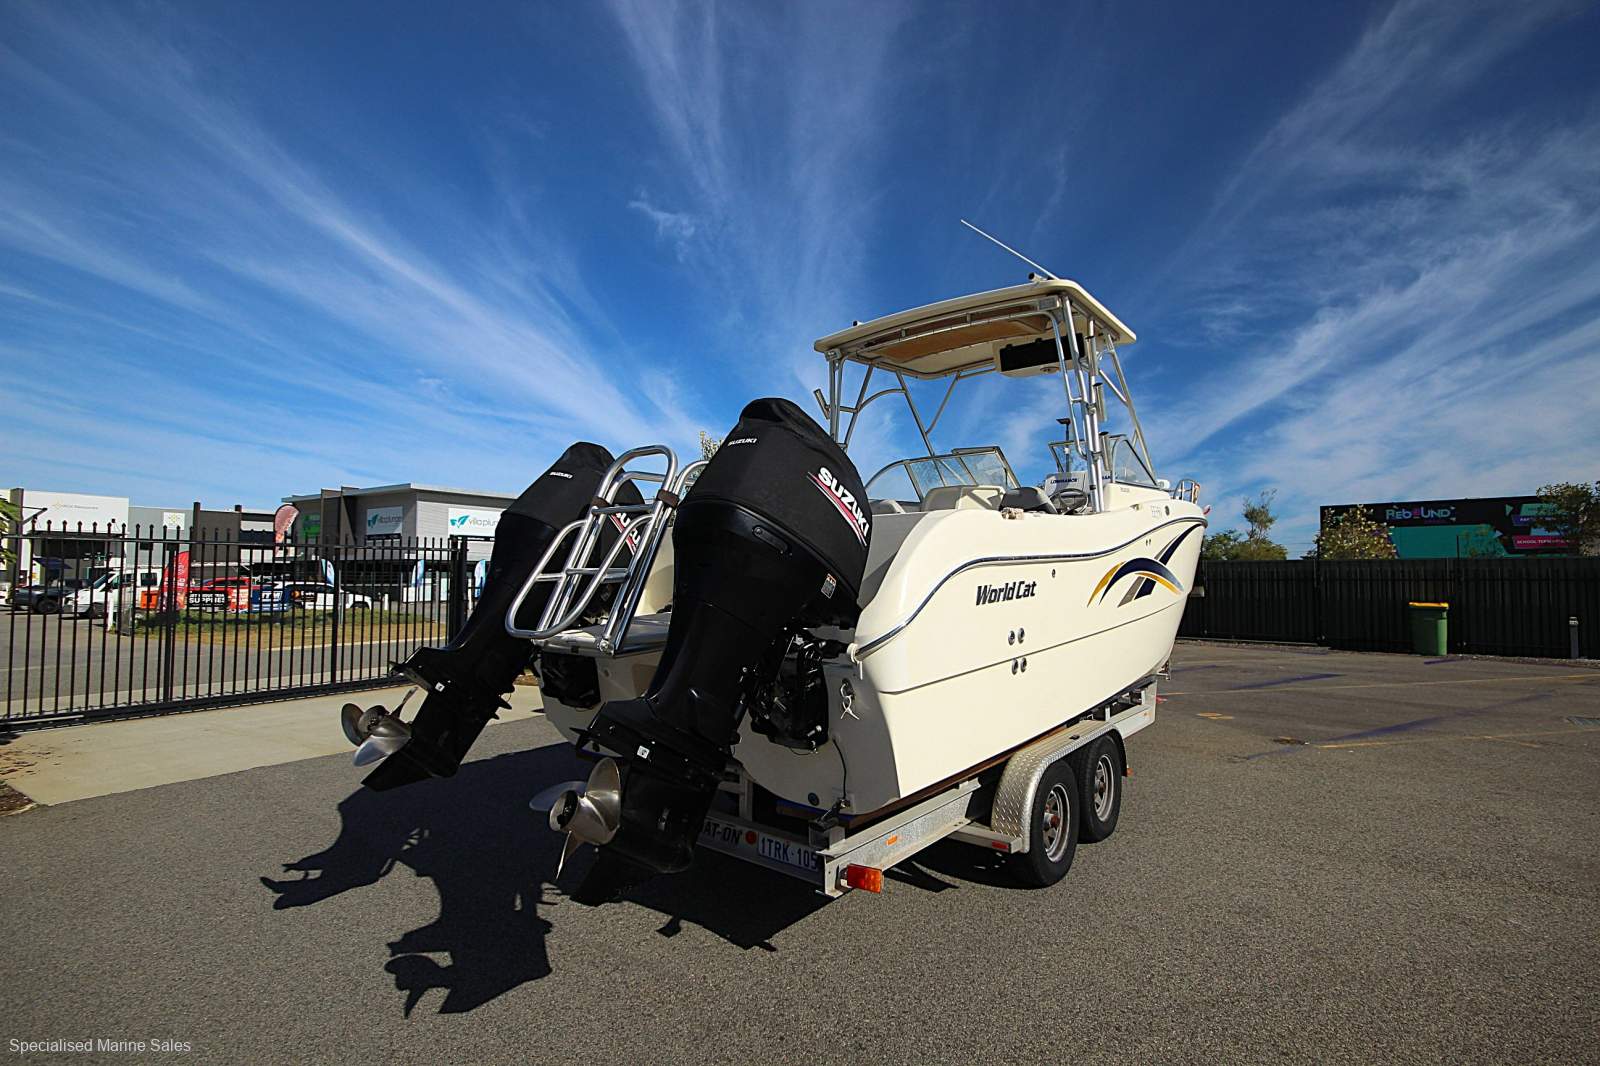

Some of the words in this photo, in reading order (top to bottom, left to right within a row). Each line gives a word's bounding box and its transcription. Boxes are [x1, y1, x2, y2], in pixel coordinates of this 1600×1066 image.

[727, 437, 758, 447] SUZUKI
[818, 466, 870, 537] SUZUKI
[976, 581, 1016, 606] World
[1015, 580, 1037, 599] Cat
